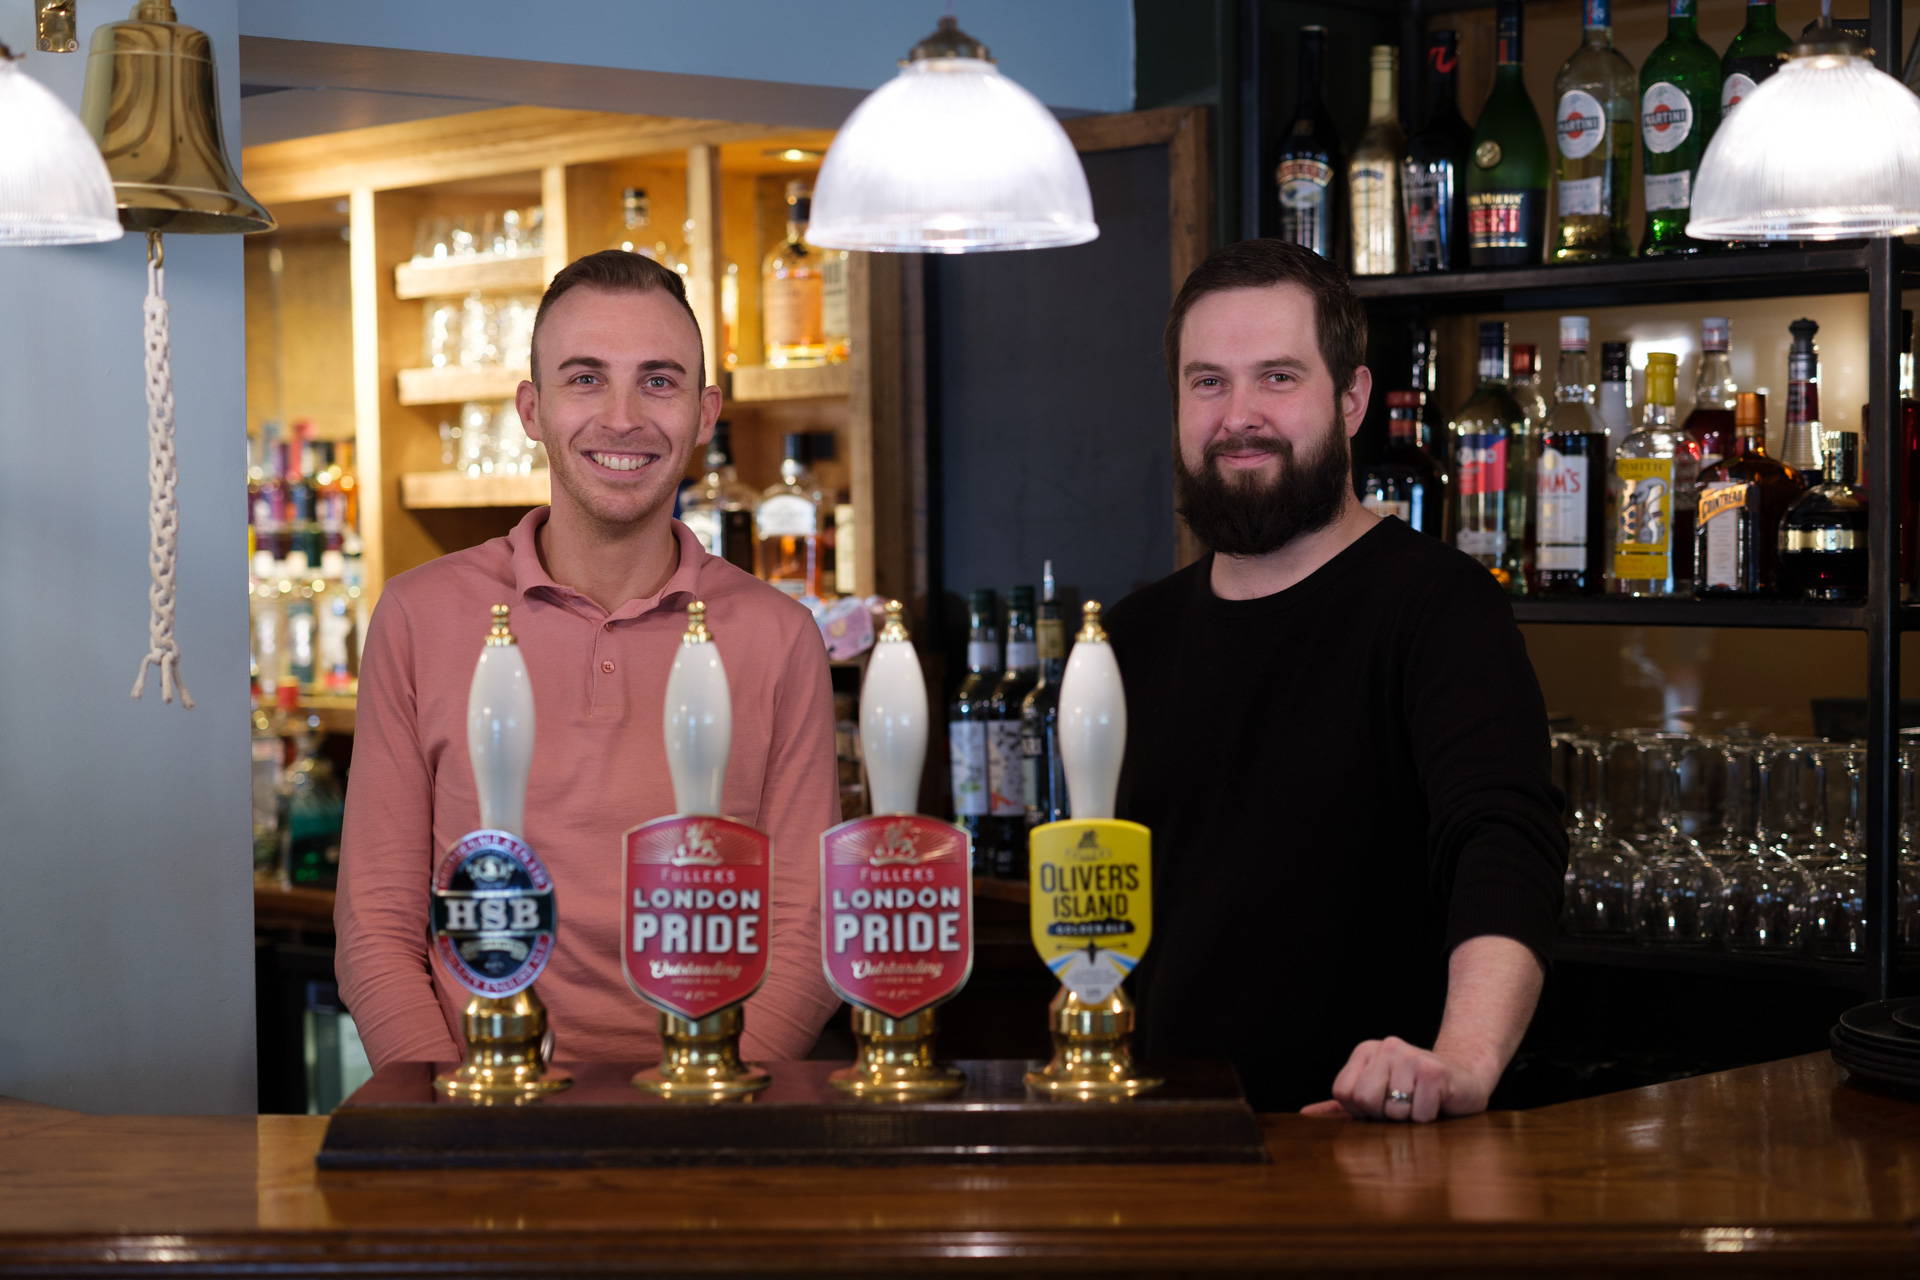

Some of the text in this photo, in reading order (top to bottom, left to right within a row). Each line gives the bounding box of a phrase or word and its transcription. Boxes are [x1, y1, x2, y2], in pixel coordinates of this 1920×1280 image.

[633, 888, 761, 910] LONDON
[833, 887, 961, 910] LONDON
[1053, 894, 1128, 918] ISLAND
[445, 898, 540, 930] HSB
[633, 913, 760, 954] PRIDE
[834, 912, 961, 953] PRIDE
